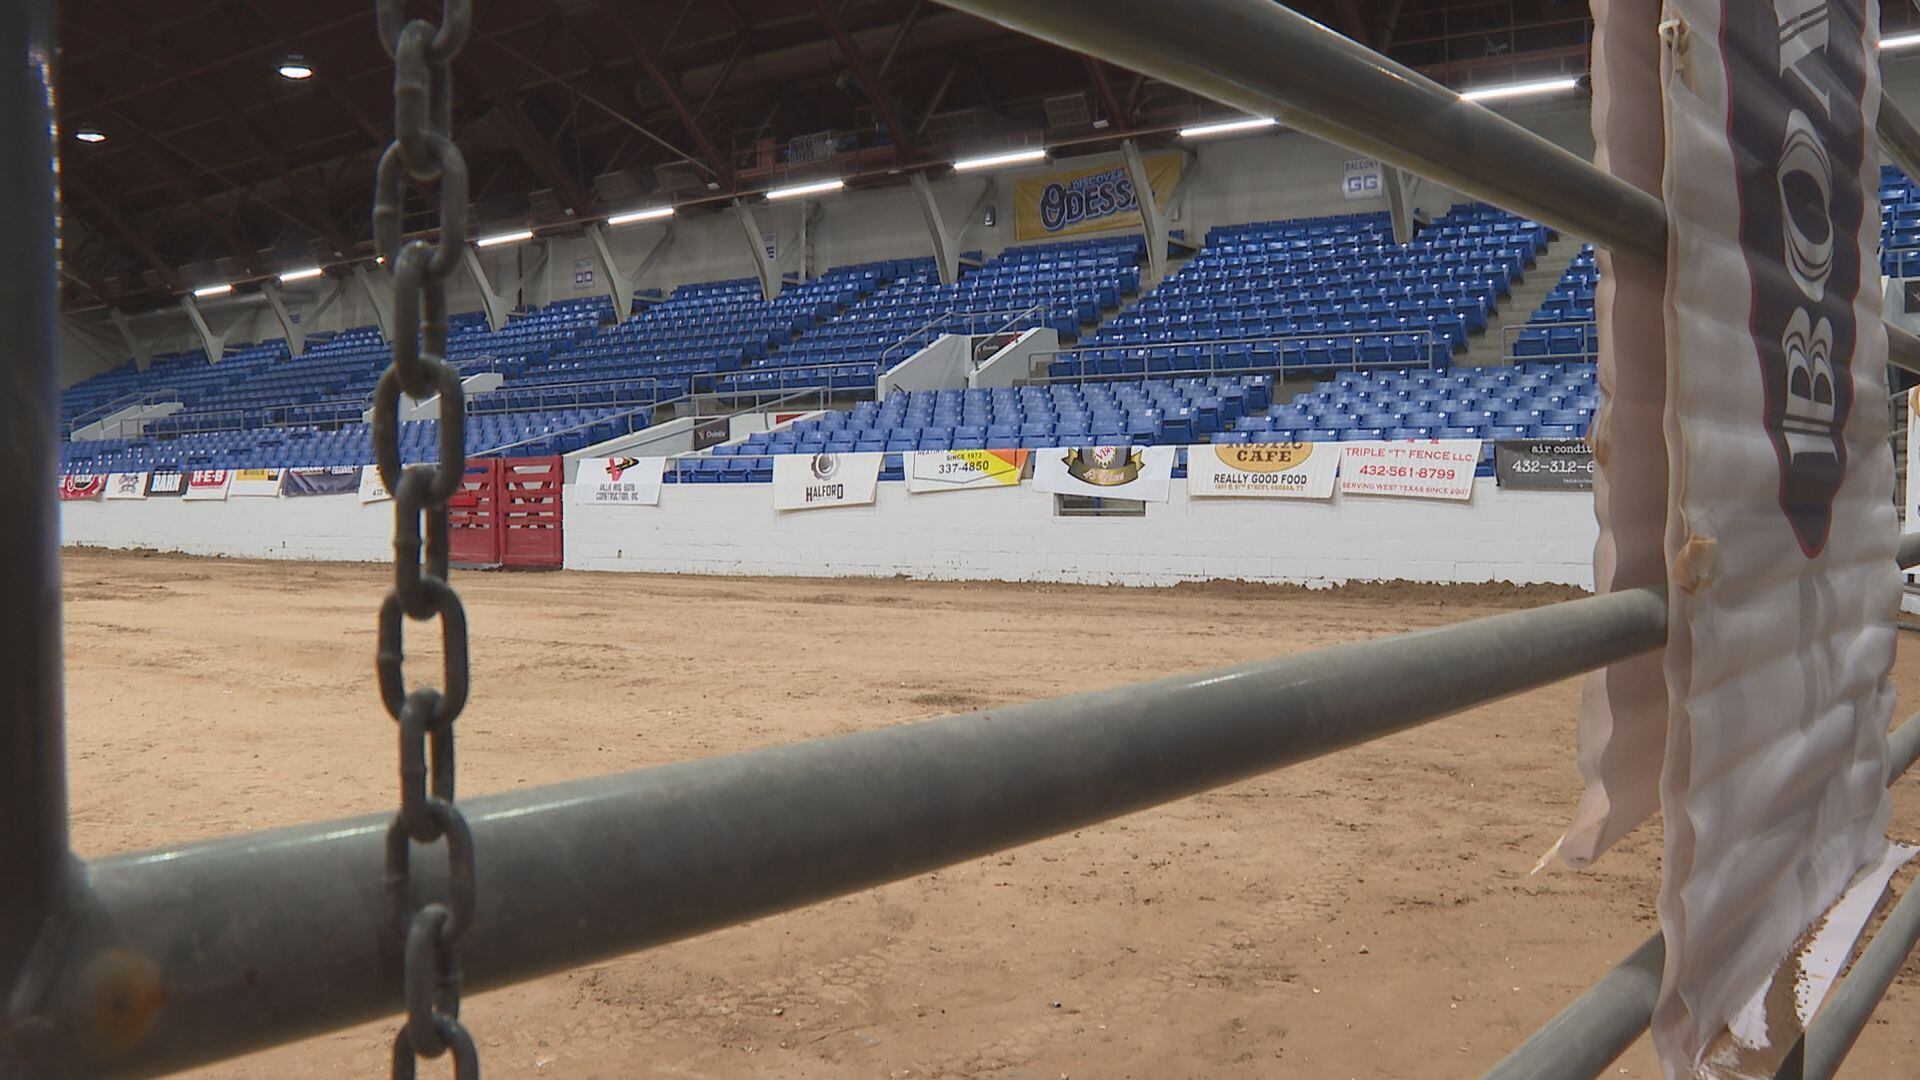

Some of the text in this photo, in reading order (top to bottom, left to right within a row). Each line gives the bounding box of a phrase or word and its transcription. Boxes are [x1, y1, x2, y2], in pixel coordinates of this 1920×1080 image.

[1071, 168, 1125, 189] DISCOVER
[1040, 178, 1139, 231] ODESS
[1345, 447, 1385, 457] TRIPLE
[1408, 450, 1450, 461] FENCE
[1531, 443, 1593, 454] air condit
[946, 453, 965, 461] SINCE
[1236, 450, 1291, 462] CAFE
[939, 460, 989, 474] 337-4850
[1512, 460, 1594, 473] 432-312-6
[151, 474, 183, 492] BARN
[1213, 473, 1307, 485] REALLY GOOD FOOD
[805, 484, 844, 502] HALFORD
[1342, 482, 1374, 490] SERVING
[1376, 483, 1397, 491] WEST
[1426, 486, 1449, 494] SINCE
